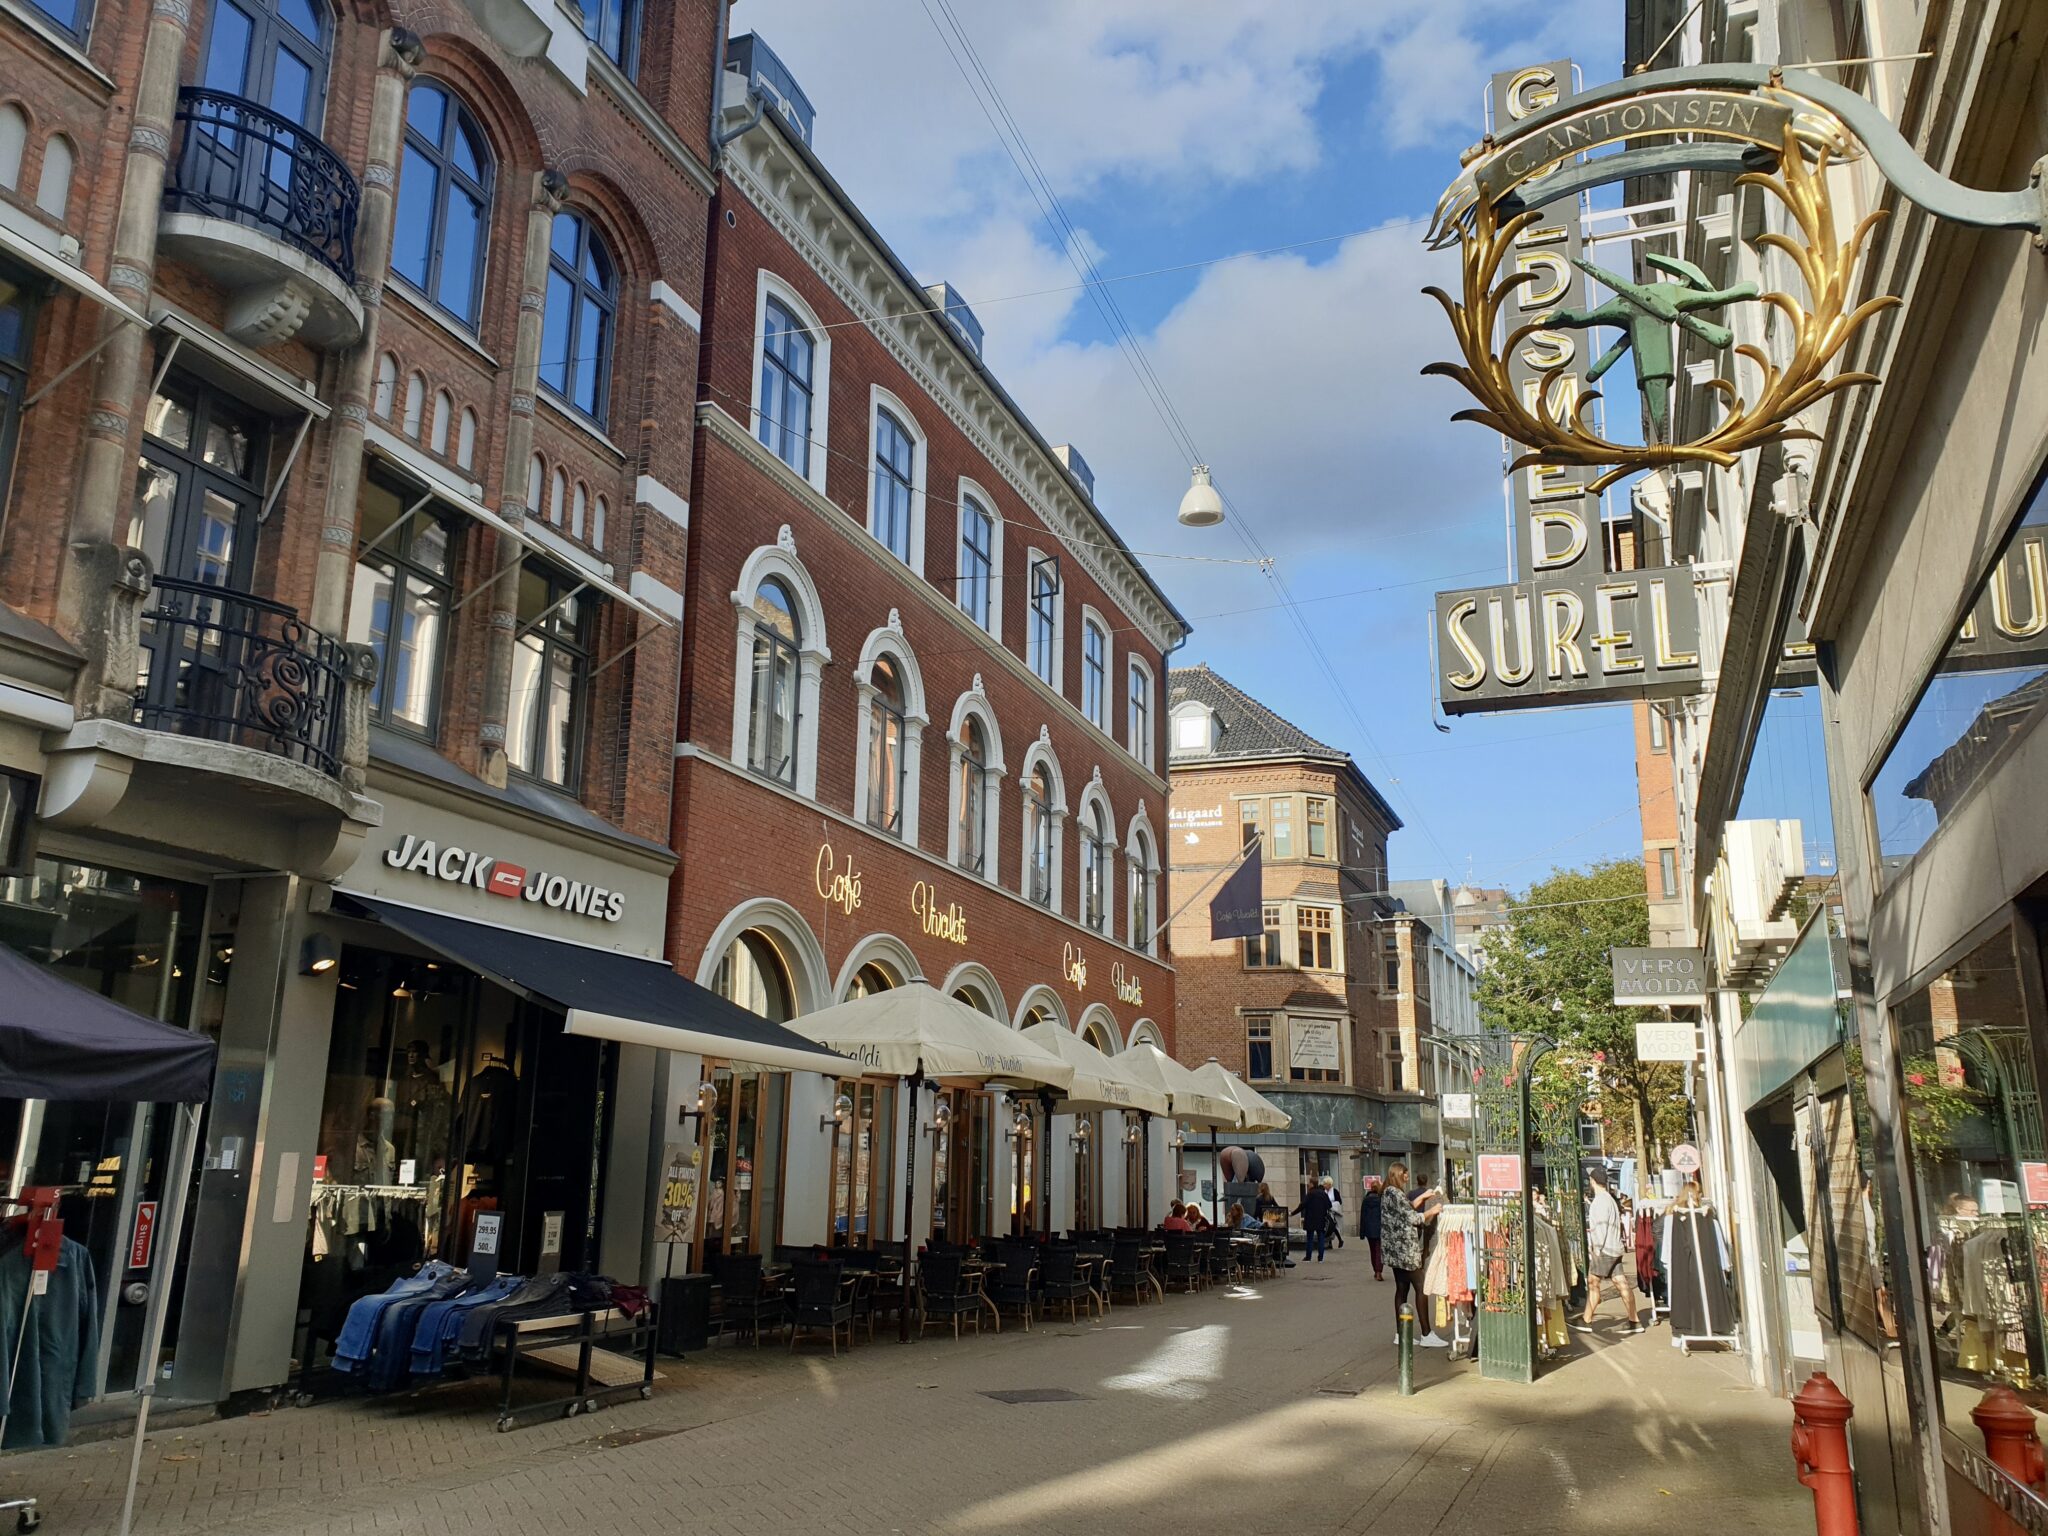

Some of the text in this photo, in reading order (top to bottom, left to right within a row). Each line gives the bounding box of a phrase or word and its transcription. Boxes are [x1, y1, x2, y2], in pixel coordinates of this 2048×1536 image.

[1544, 99, 1760, 158] ANTONSEN
[1506, 66, 1589, 573] GDSMED
[1445, 577, 1699, 690] SUREL
[384, 834, 625, 923] JACK JONES
[816, 843, 968, 946] Café Vivaldi
[1063, 941, 1143, 1007] Café Vivaldi
[1622, 958, 1694, 974] VERO
[1619, 978, 1700, 993] MODA
[1642, 1030, 1689, 1041] VERO
[1641, 1042, 1694, 1053] MODA
[668, 1166, 678, 1179] ALL
[53, 1188, 60, 1199] S
[664, 1182, 693, 1208] 30%
[671, 1210, 683, 1222] OFF
[478, 1225, 497, 1235] 299,95
